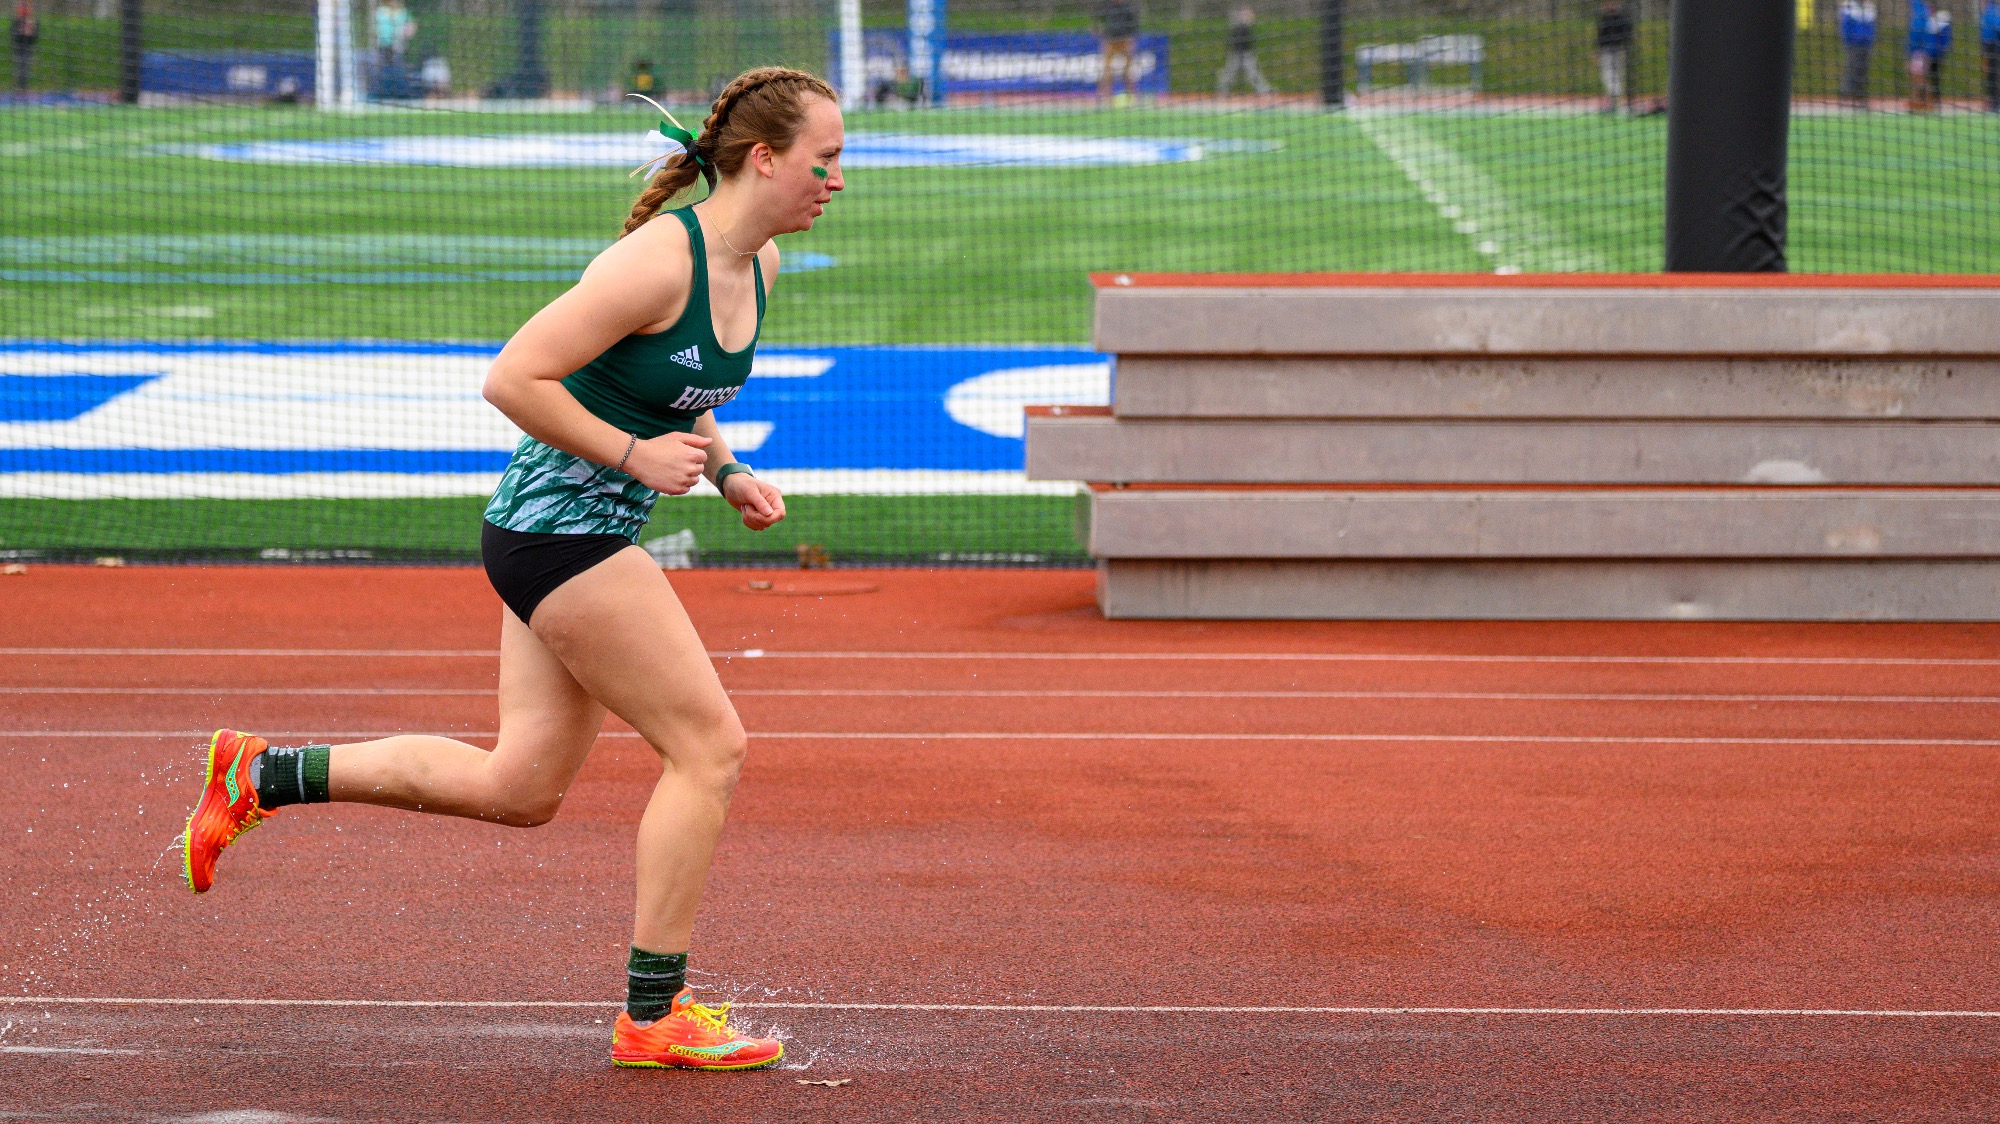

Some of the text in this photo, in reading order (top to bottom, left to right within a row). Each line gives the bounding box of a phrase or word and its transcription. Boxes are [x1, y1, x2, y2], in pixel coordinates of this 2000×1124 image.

[670, 354, 703, 371] adidas
[669, 385, 742, 410] HUSSO
[668, 1044, 723, 1061] saucony
